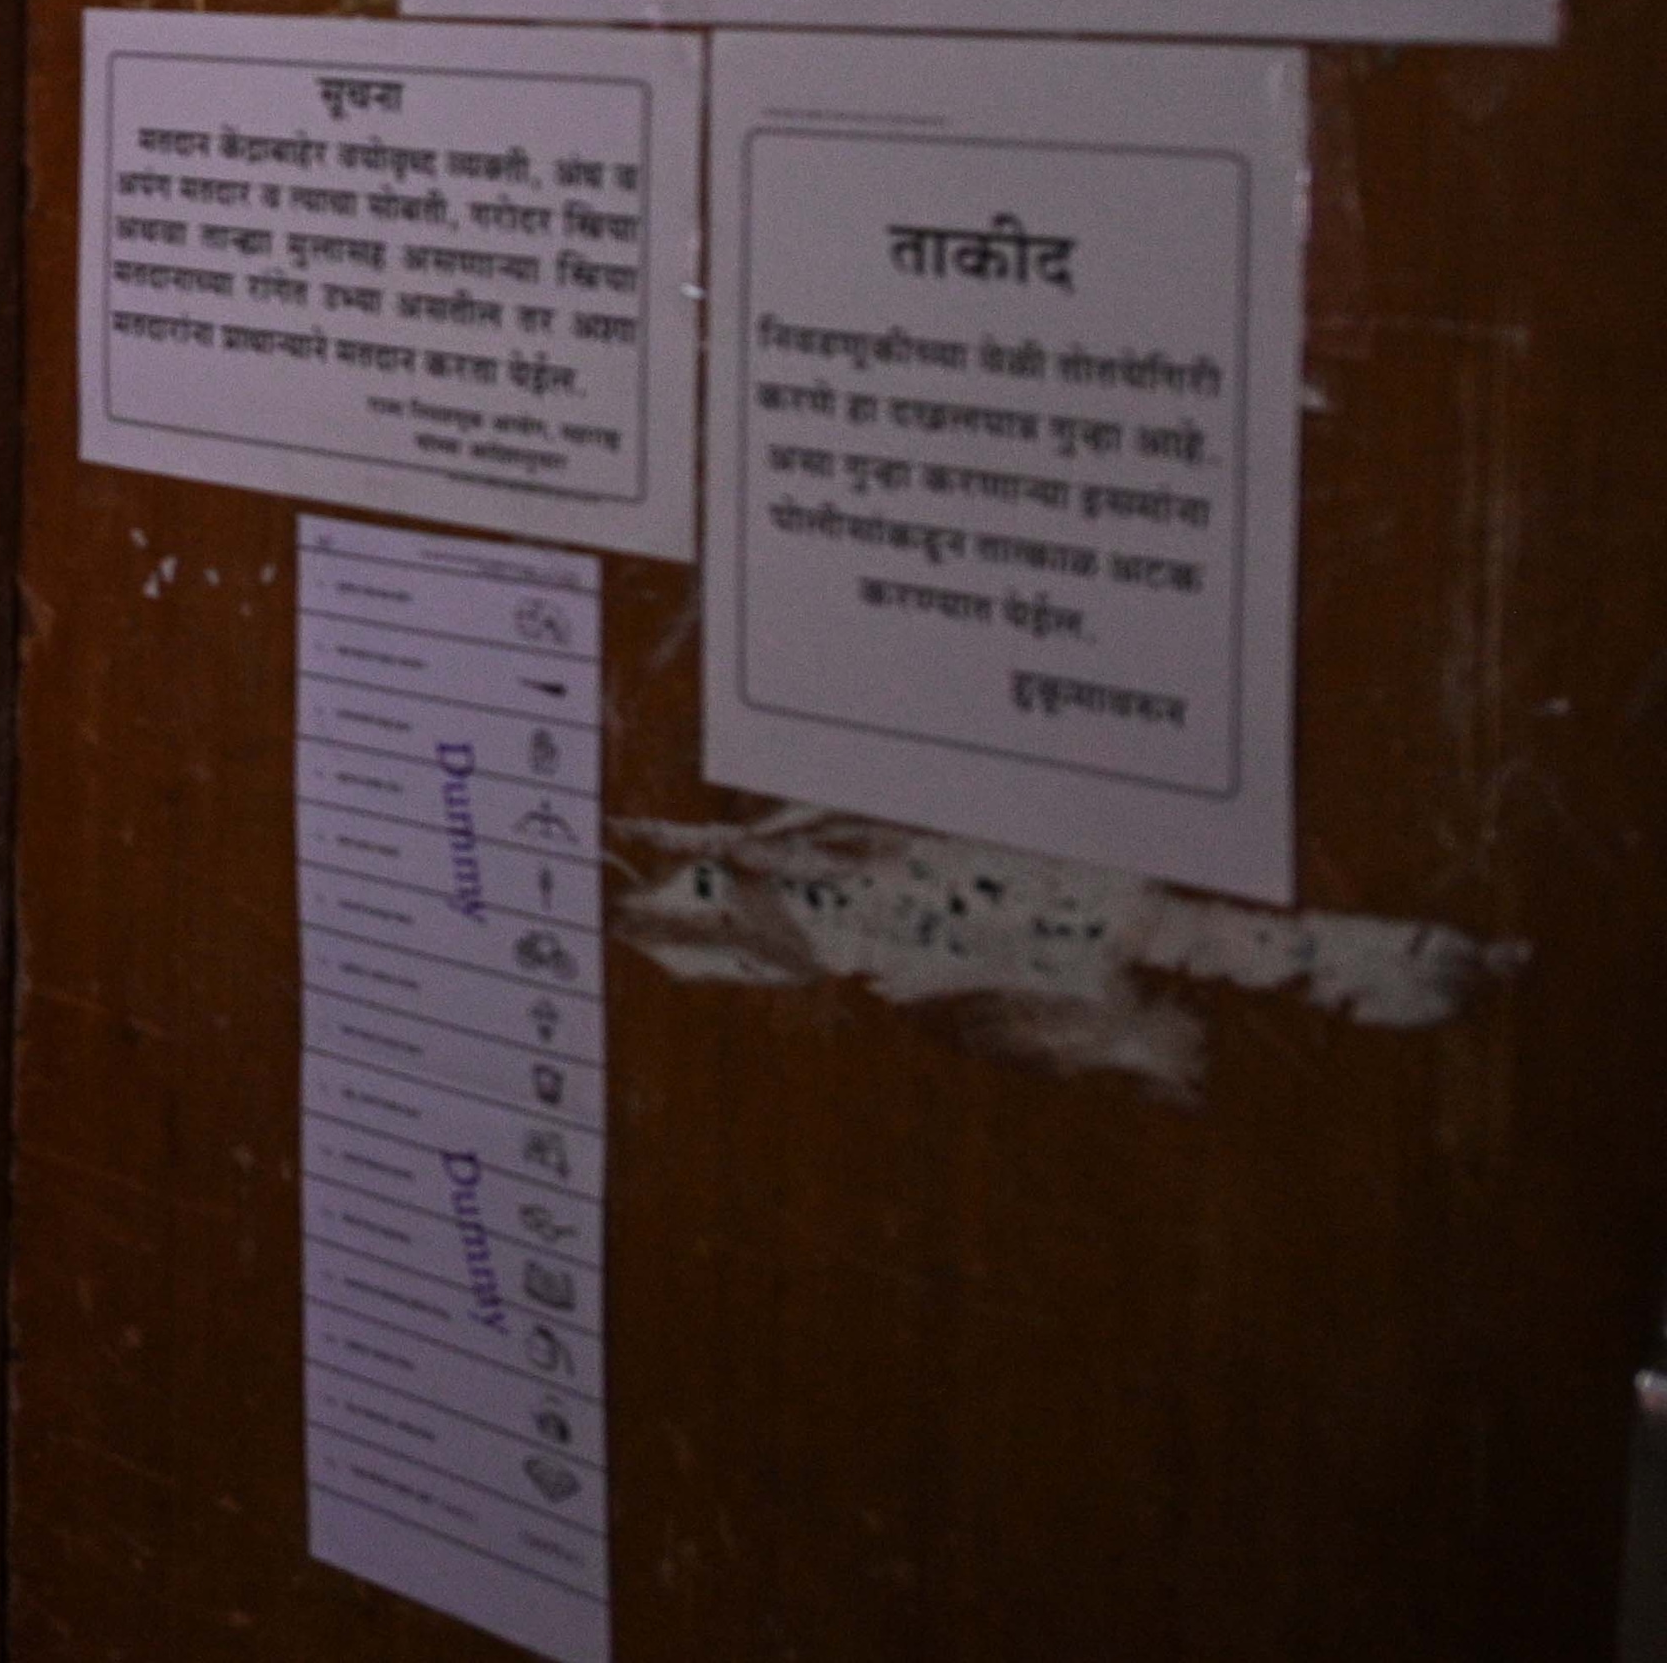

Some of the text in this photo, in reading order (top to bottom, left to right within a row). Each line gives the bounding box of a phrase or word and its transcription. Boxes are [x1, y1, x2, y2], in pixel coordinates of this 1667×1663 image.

[887, 214, 1075, 293] ताकीद
[437, 742, 486, 924] Dummy
[440, 1150, 510, 1334] Dummy
